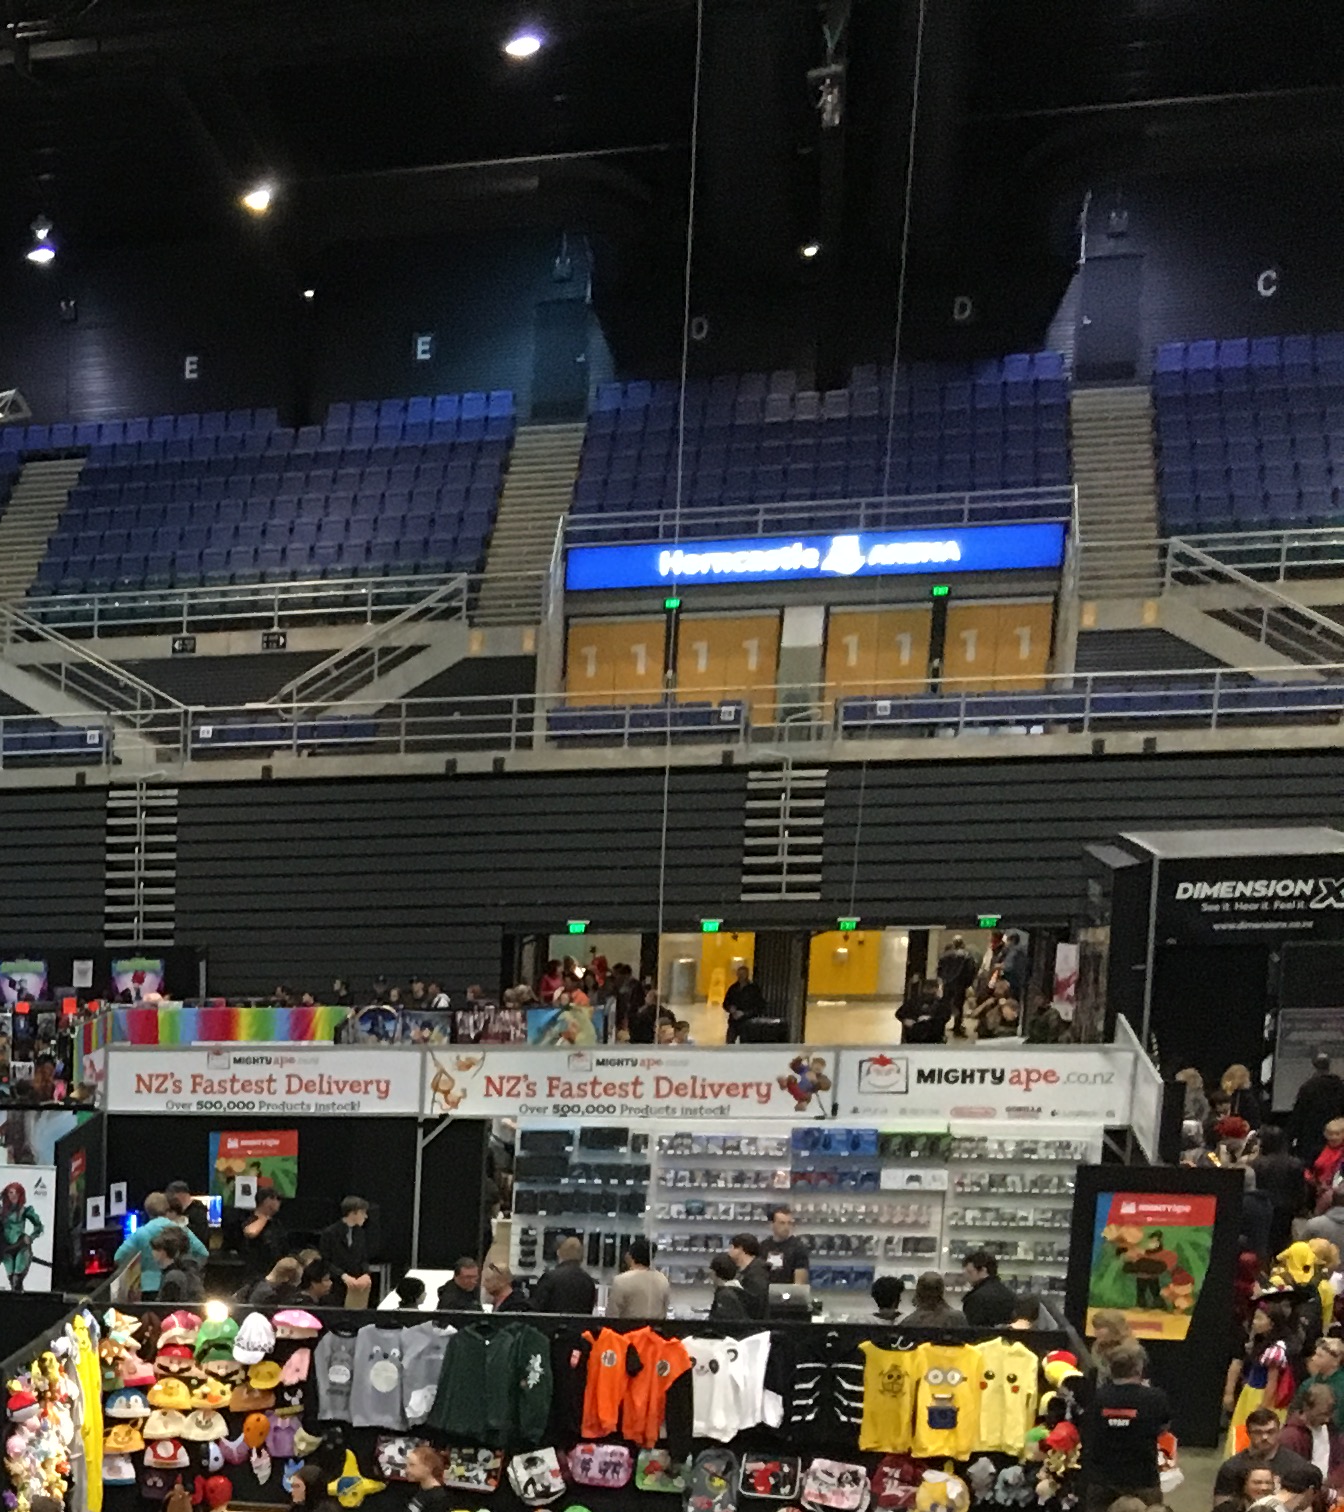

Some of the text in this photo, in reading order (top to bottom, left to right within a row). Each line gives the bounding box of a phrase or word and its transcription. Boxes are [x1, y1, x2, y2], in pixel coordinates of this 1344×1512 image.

[1256, 271, 1277, 296] C
[417, 336, 431, 360] E
[185, 356, 199, 379] E
[692, 641, 709, 673] 1
[743, 639, 760, 671] 1
[842, 634, 859, 667] 1
[895, 632, 912, 665] 1
[959, 629, 978, 662] 1
[1014, 626, 1032, 659] 1
[580, 645, 597, 677] 1
[630, 643, 648, 675] 1
[1175, 879, 1314, 899] DIMENSION
[134, 1072, 391, 1099] NZ's Fastest Delivery
[483, 1075, 773, 1104] NZ's Fastest Delivery
[916, 1068, 1005, 1085] MIGHTY
[165, 1100, 193, 1110] Over
[196, 1100, 255, 1112] 500,000
[258, 1100, 312, 1111] Products
[519, 1104, 549, 1115] Over
[552, 1104, 616, 1116] 500,000
[620, 1104, 677, 1116] Products
